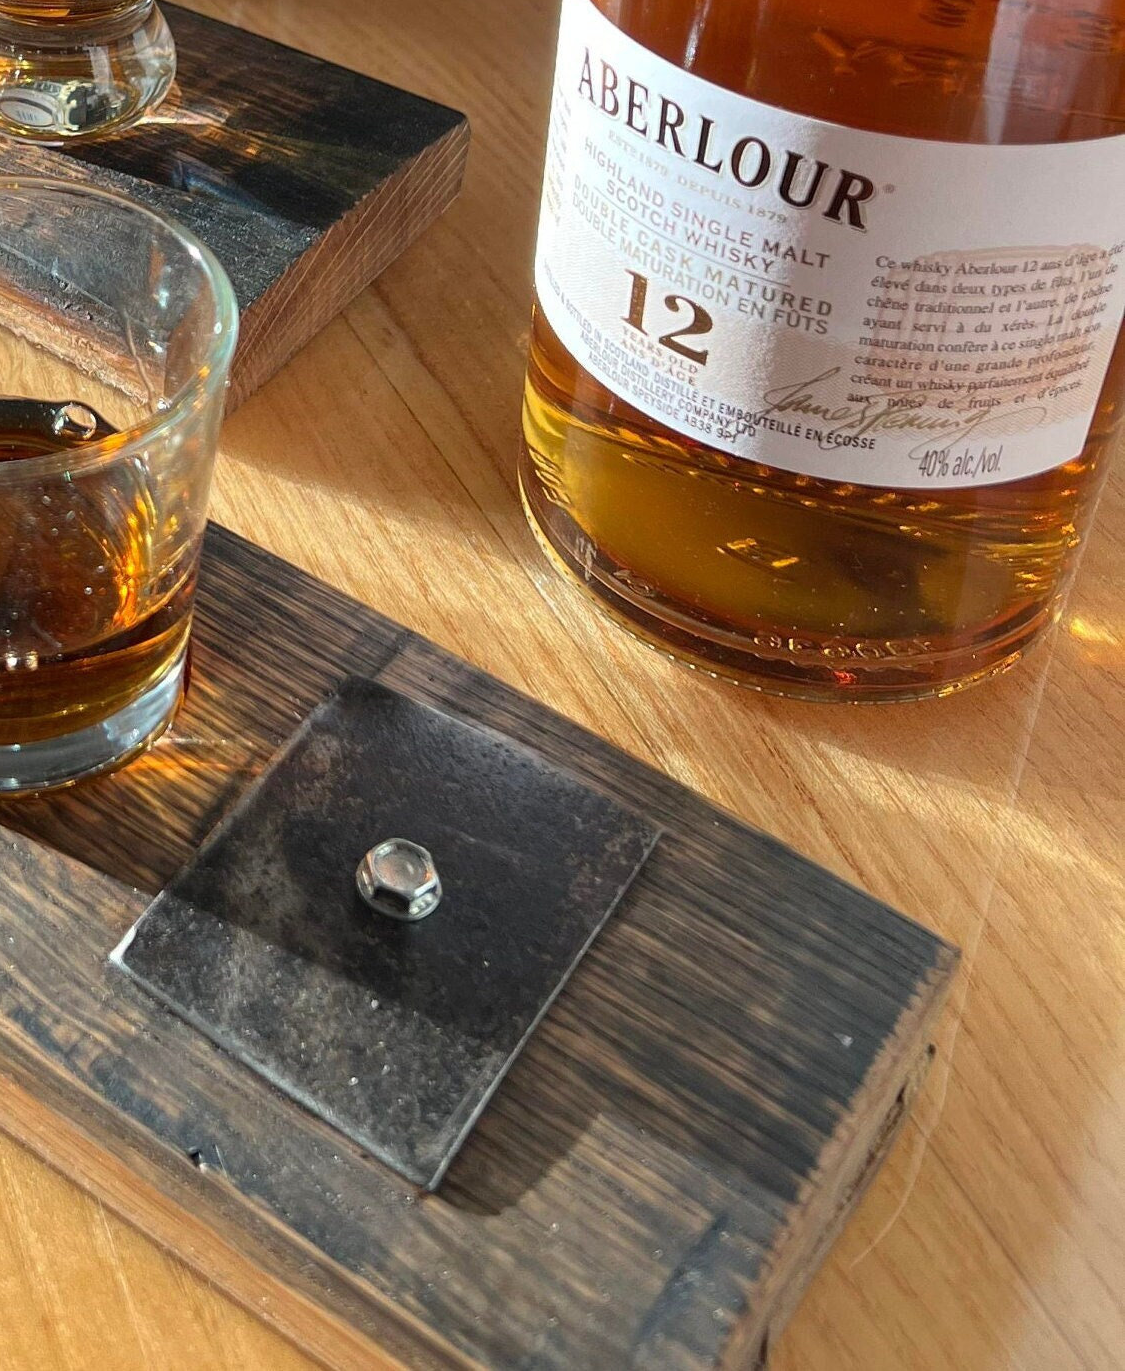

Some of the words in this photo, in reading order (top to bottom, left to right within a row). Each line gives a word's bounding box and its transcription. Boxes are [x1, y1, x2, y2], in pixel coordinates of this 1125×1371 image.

[577, 46, 878, 233] ABERLOUR
[584, 136, 665, 209] HIGHLAND
[670, 201, 754, 250] SINGLE
[761, 237, 831, 269] MALT
[676, 174, 742, 210] DEPUIS
[747, 202, 787, 225] 1879
[574, 173, 629, 236] DOUBLE
[637, 229, 694, 272] CASK
[704, 265, 833, 317] MATURED
[606, 178, 677, 236] SCOTCH
[685, 226, 776, 275] WHISKY
[572, 191, 617, 246] DOUBLE
[619, 235, 730, 307] MATURATION
[737, 297, 766, 320] EN
[773, 307, 829, 335] FÛTS
[869, 275, 910, 291] élevé
[913, 280, 948, 294] dans
[951, 281, 986, 295] deux
[990, 283, 1026, 298] types
[1029, 279, 1048, 292] de
[1104, 262, 1119, 276] de
[875, 255, 897, 270] Ce
[900, 259, 953, 276] whisky
[954, 261, 1019, 276] Aberlour
[1021, 259, 1038, 273] 12
[1039, 259, 1063, 271] ans
[620, 268, 714, 367] 12
[861, 316, 903, 332] ayant
[912, 320, 948, 334] servi
[955, 321, 965, 334] à
[974, 320, 993, 334] du
[1046, 313, 1064, 327] La
[1070, 300, 1108, 322] double
[865, 295, 909, 311] chêne
[913, 299, 995, 315] traditionnel
[998, 301, 1012, 314] et
[1063, 293, 1079, 305] de
[620, 337, 647, 360] ANS
[622, 325, 664, 357] YEARS
[668, 354, 699, 376] OLD
[853, 353, 923, 371] caractère
[928, 359, 971, 372] d'une
[975, 357, 1024, 374] grande
[858, 335, 935, 353] maturation
[936, 340, 989, 354] confère
[990, 340, 1000, 352] à
[1000, 341, 1017, 352] ce
[1018, 333, 1056, 351] single
[579, 330, 621, 373] ABERLOUR
[620, 363, 675, 405] DISTILLERY
[677, 396, 732, 428] COMPANY
[734, 419, 757, 438] LTD
[587, 350, 630, 393] ABERLOUR
[630, 383, 680, 422] SPEYSIDE
[683, 414, 713, 435] AB38
[593, 328, 604, 343] IN
[603, 338, 650, 378] SCOTLAND
[702, 395, 716, 410] ET
[718, 402, 802, 438] EMBOUTEILLÉ
[805, 427, 824, 442] EN
[826, 429, 877, 451] ÉCOSSE
[846, 392, 873, 405] aux
[937, 397, 955, 410] de
[967, 394, 1003, 409] fruits
[1014, 392, 1026, 404] et
[848, 373, 892, 388] créant
[895, 379, 914, 390] un
[917, 378, 965, 393] whisky
[966, 372, 1045, 394] parfaitement
[918, 448, 951, 478] 40%
